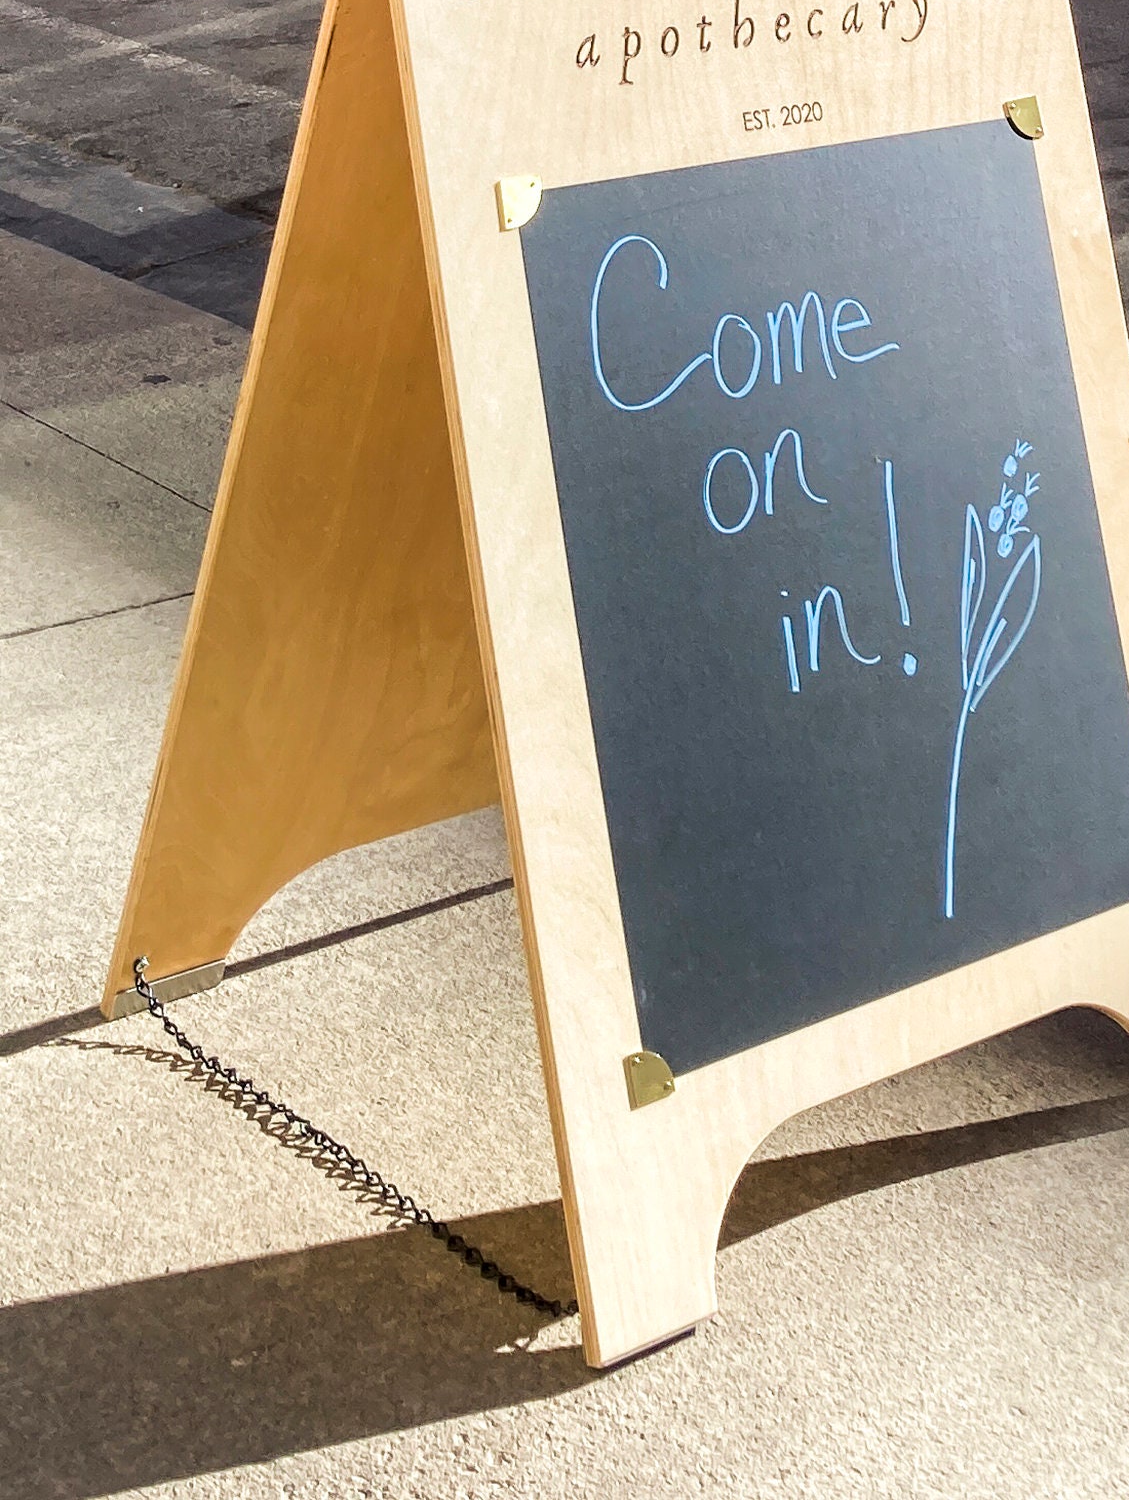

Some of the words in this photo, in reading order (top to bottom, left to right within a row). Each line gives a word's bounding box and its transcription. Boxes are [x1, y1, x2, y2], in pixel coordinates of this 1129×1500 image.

[743, 109, 776, 133] EST.
[780, 101, 824, 127] 2020
[591, 234, 900, 412] Come
[703, 427, 828, 534] on
